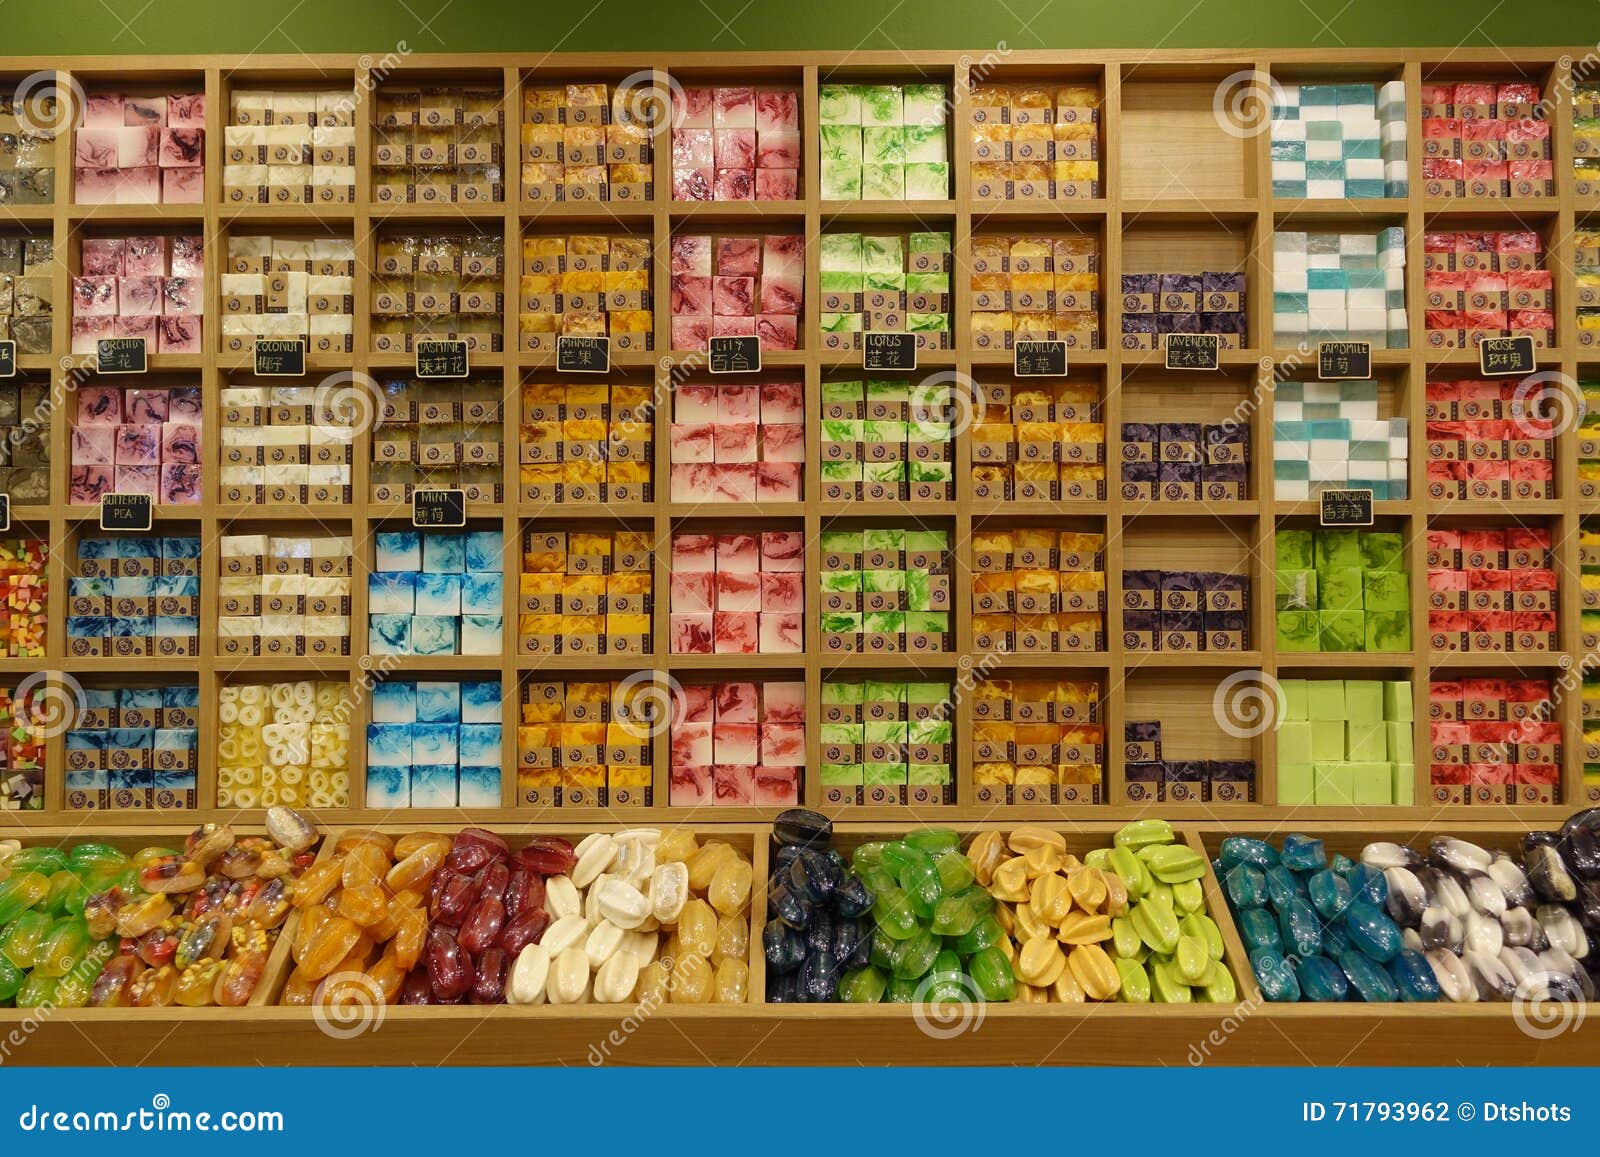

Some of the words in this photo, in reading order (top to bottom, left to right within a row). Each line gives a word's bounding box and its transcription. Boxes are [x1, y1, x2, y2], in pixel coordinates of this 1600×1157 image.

[102, 340, 138, 350] ORCHID
[256, 341, 297, 352] COCONUT
[561, 338, 598, 349] MANGO
[869, 335, 902, 347] LOTUS
[1169, 335, 1216, 348] LAVENDER
[1487, 340, 1516, 351] ROSE
[418, 341, 461, 353] JASMINE
[1017, 341, 1061, 353] VANILLA
[1320, 343, 1368, 354] CAMOMILE
[561, 350, 593, 366] 芒果
[712, 353, 750, 371] 百合
[1018, 355, 1052, 373] 香草
[104, 495, 150, 505] BUTTERFLY
[421, 491, 448, 502] MINT
[114, 508, 133, 518] PEA
